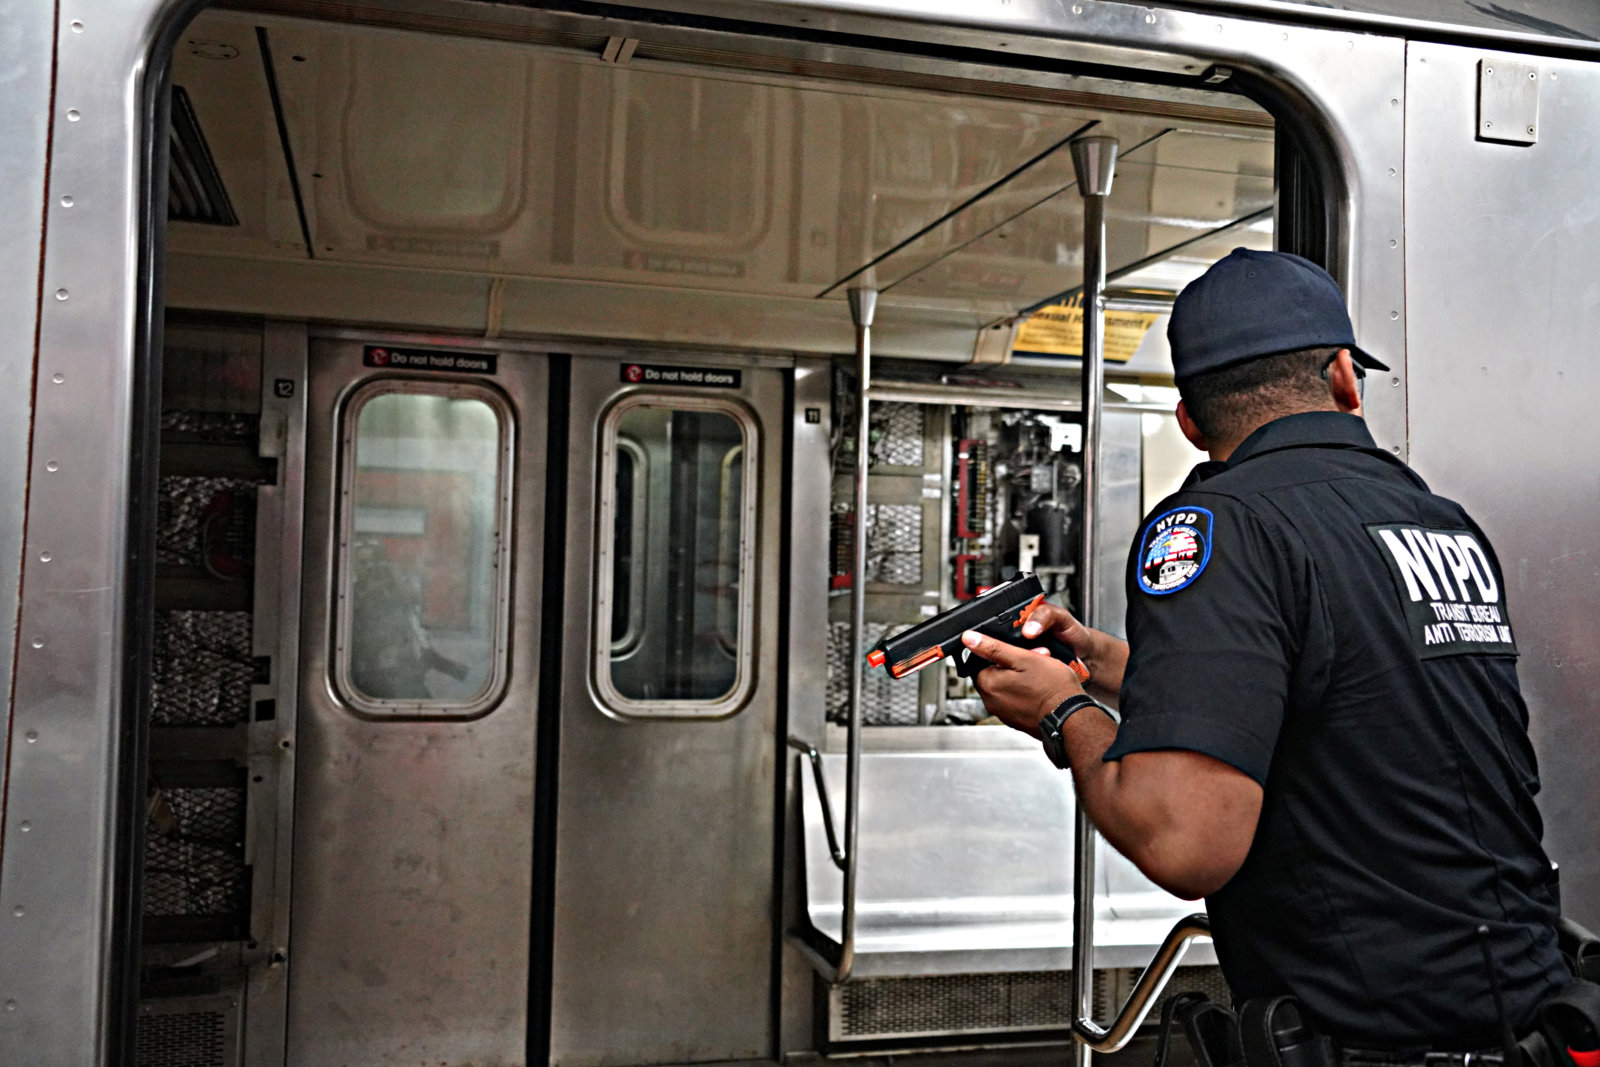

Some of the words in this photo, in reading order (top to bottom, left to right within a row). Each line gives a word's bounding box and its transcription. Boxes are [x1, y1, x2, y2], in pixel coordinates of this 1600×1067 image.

[391, 352, 407, 363] Do
[409, 355, 427, 365] not
[430, 355, 454, 367] hold
[456, 358, 488, 370] doors
[645, 369, 659, 380] Do
[662, 371, 678, 381] not
[681, 371, 703, 382] hold
[704, 372, 734, 384] doors
[278, 382, 292, 395] 12
[1156, 513, 1197, 532] NYPD
[1378, 528, 1499, 603] NYPD
[1429, 602, 1471, 622] TRANSIT
[1468, 604, 1501, 623] BUREAU
[1424, 622, 1456, 645] ANTI
[1453, 622, 1500, 643] TERRORISM
